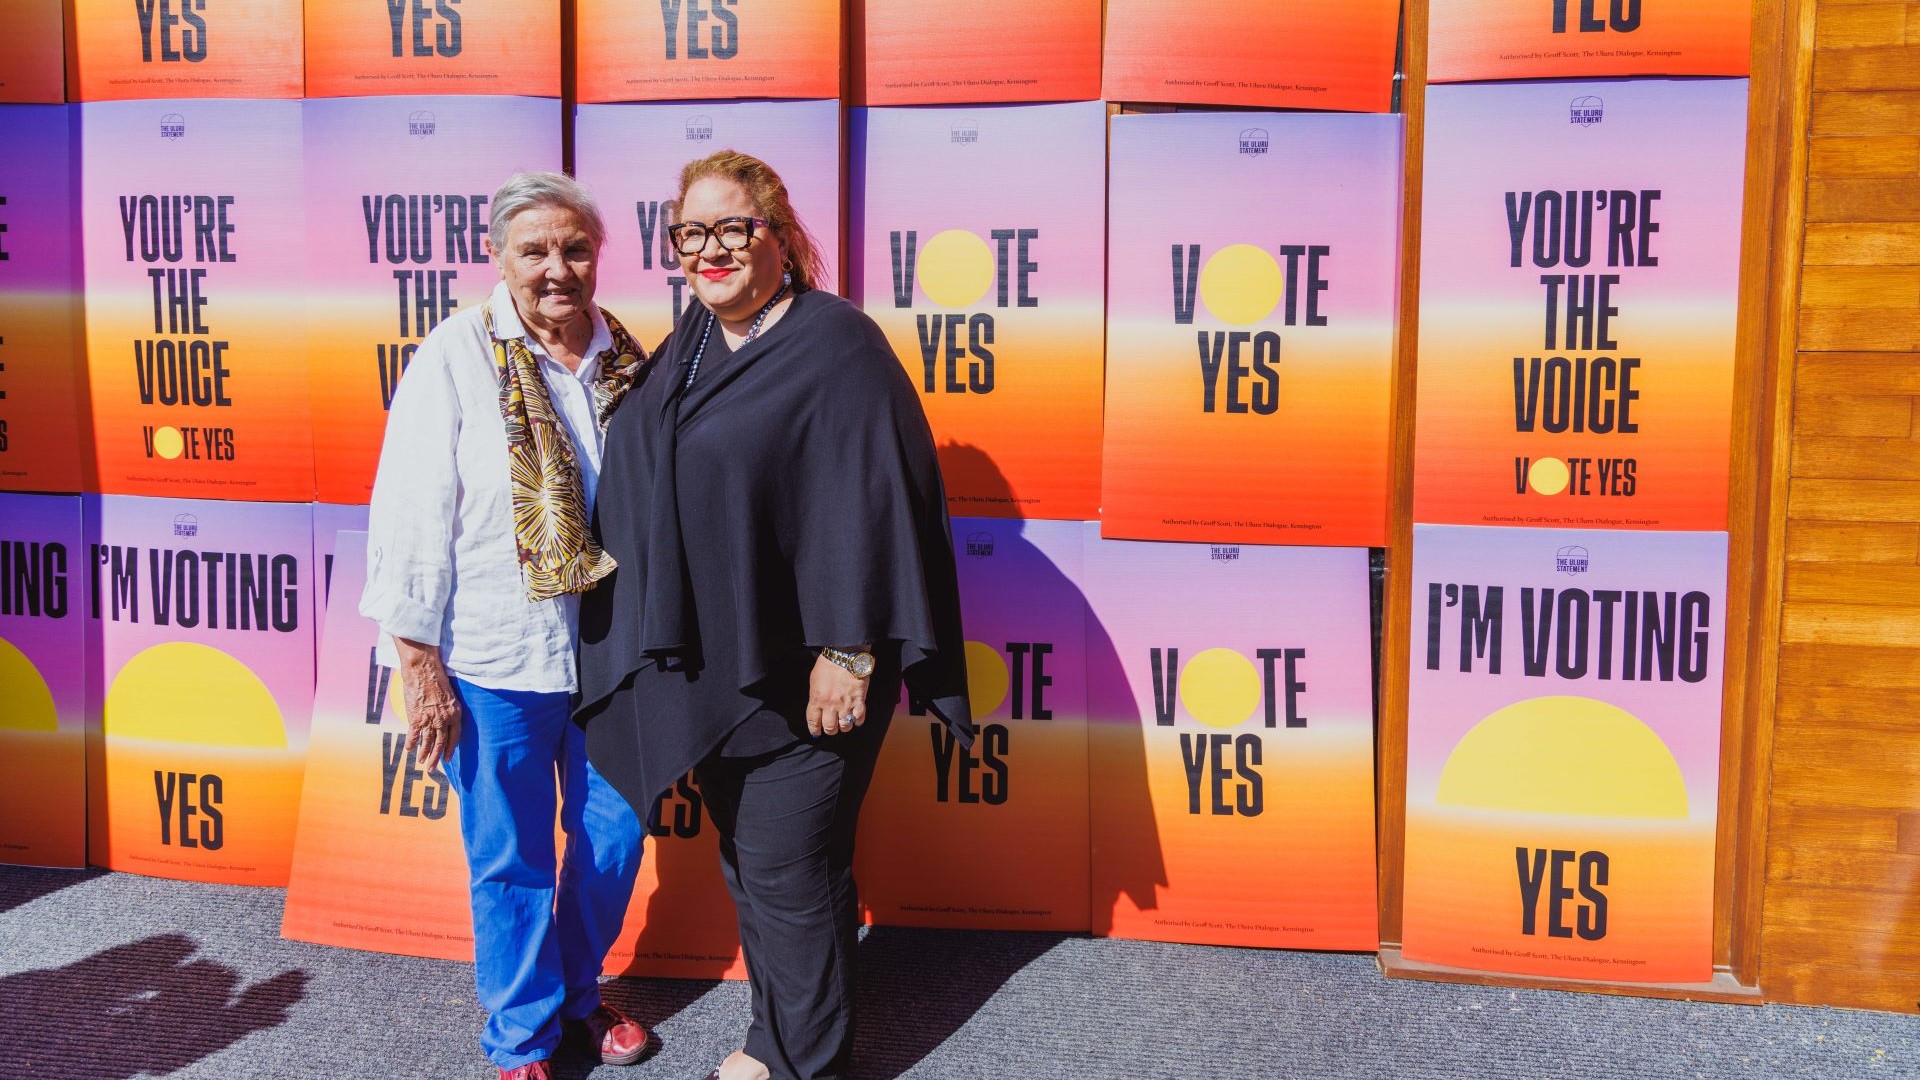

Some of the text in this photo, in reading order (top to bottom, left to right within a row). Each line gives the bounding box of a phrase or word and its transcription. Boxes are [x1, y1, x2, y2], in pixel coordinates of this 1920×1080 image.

[136, 0, 207, 62] YES
[387, 0, 462, 57] YES
[660, 0, 738, 60] YES
[1616, 50, 1645, 58] Dialogue,
[1647, 50, 1682, 58] Kensington
[119, 195, 236, 262] YOU'RE
[362, 194, 489, 264] YOU'RE
[1505, 190, 1661, 268] YOU'RE
[148, 269, 208, 334] THE
[393, 270, 457, 337] THE
[1540, 275, 1620, 350] THE
[135, 340, 231, 406] VOICE
[917, 313, 994, 394] YES
[1198, 331, 1280, 415] YES
[1513, 357, 1640, 433] VOICE
[203, 428, 234, 460] YES
[1598, 458, 1636, 497] YES
[90, 544, 138, 623] I'M
[150, 548, 298, 632] VOTING
[1426, 583, 1710, 683] I'M VOTING
[930, 723, 1008, 805] YES
[1180, 733, 1263, 817] YES
[154, 770, 223, 850] YES
[646, 771, 702, 839] ES
[1515, 847, 1609, 940] YES
[1514, 950, 1531, 958] Geoff
